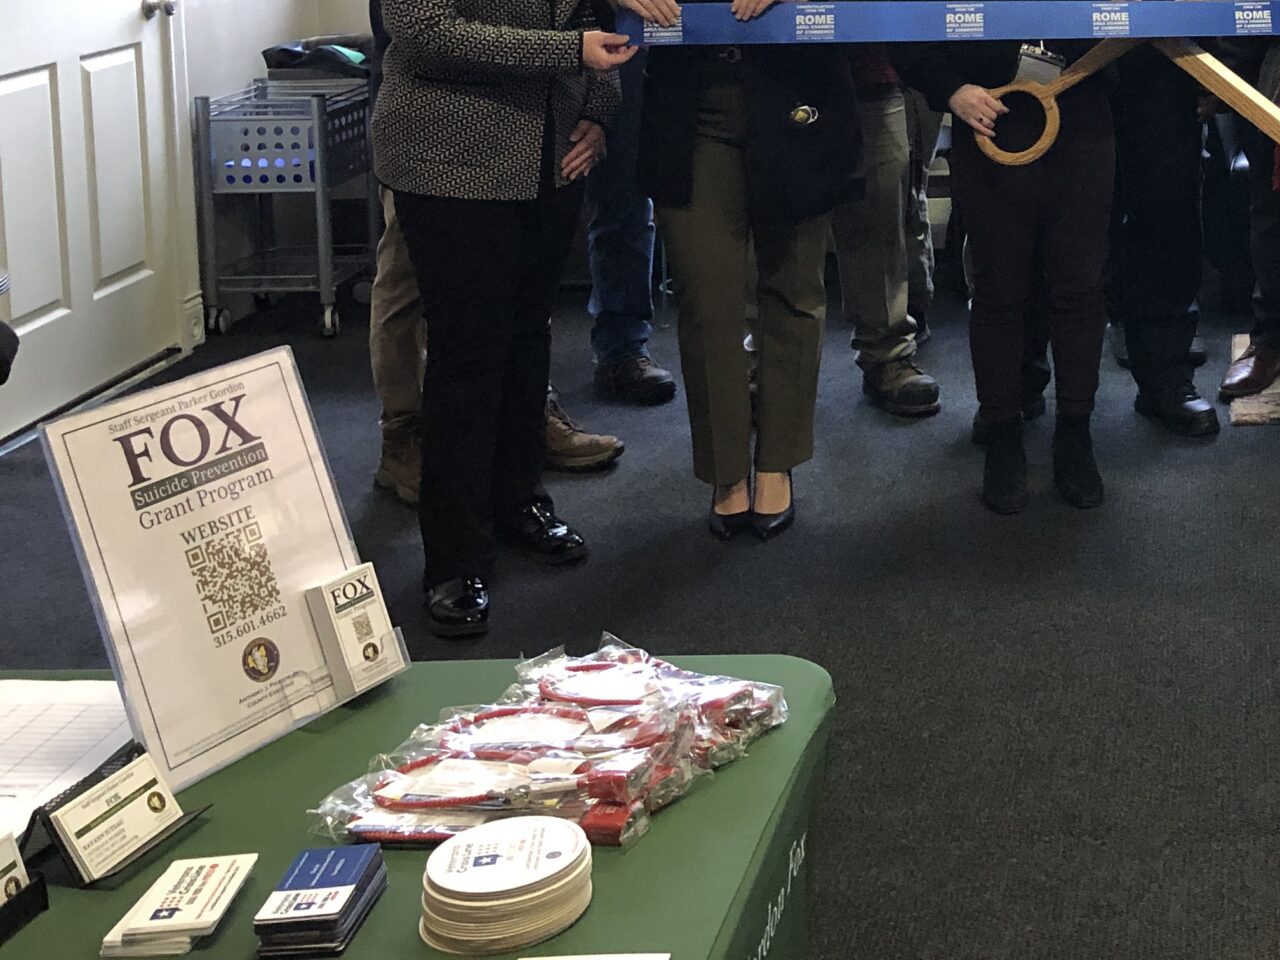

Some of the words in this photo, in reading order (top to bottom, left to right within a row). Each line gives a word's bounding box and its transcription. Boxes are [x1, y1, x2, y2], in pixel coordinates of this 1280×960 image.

[796, 14, 835, 25] ROME
[946, 13, 984, 23] ROME
[1092, 12, 1129, 21] ROME
[1235, 10, 1271, 20] ROME
[108, 419, 131, 435] Staff
[133, 404, 176, 426] Sergeant
[178, 394, 207, 413] Parker
[209, 382, 245, 399] Gordon
[112, 394, 261, 488] FOX
[134, 477, 189, 507] Suicide
[191, 448, 267, 485] Prevention
[139, 496, 194, 530] Grant
[196, 467, 275, 507] Program
[179, 505, 256, 546] WEBSITE
[331, 575, 370, 606] FOX
[213, 605, 287, 648] 315.601.4662
